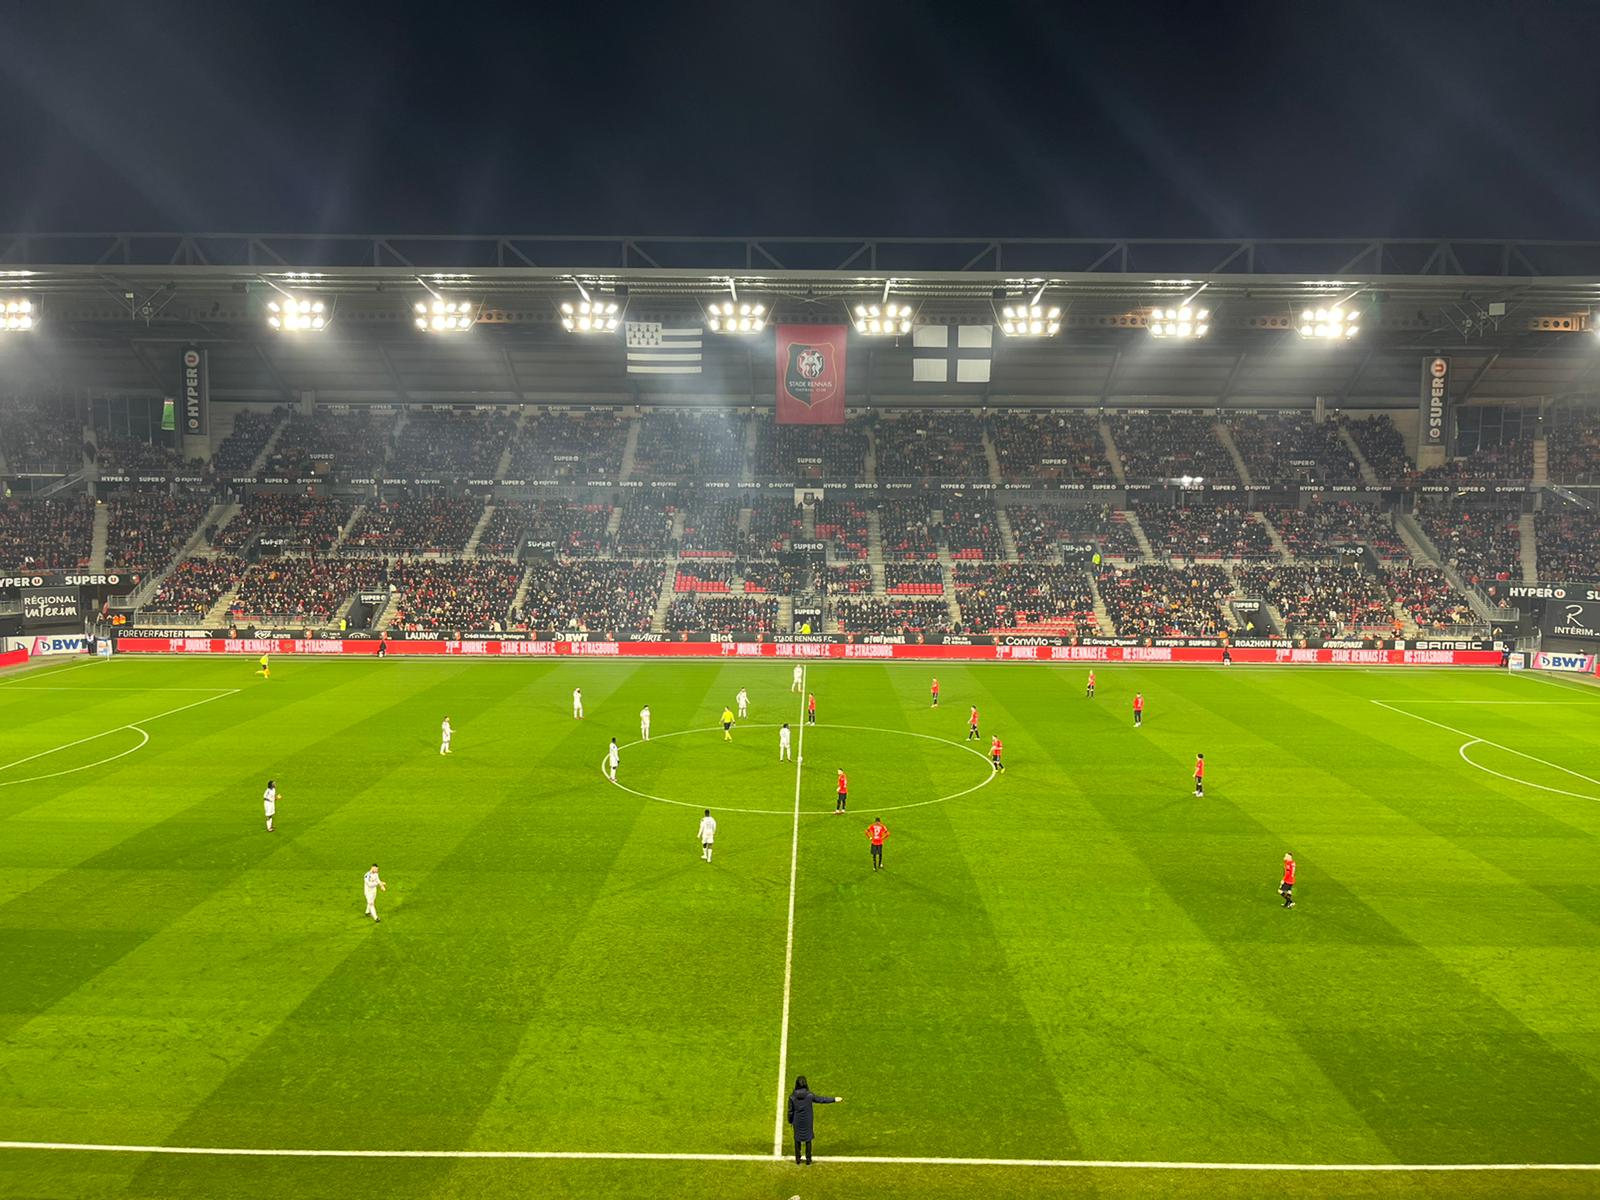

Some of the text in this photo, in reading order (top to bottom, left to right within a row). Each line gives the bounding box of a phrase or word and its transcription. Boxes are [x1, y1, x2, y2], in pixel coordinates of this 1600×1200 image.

[186, 368, 198, 417] HYPER
[1430, 378, 1444, 424] SUPER
[65, 575, 106, 585] SUPER
[1509, 588, 1552, 598] HYPER
[24, 595, 76, 605] RÉGIONAL
[405, 632, 439, 640] LAUNAY
[1554, 626, 1594, 636] INTÉRIM
[710, 633, 733, 642] Blot
[52, 638, 88, 650] BWT
[1416, 641, 1482, 650] SAMSIC
[1552, 656, 1586, 669] BWT
